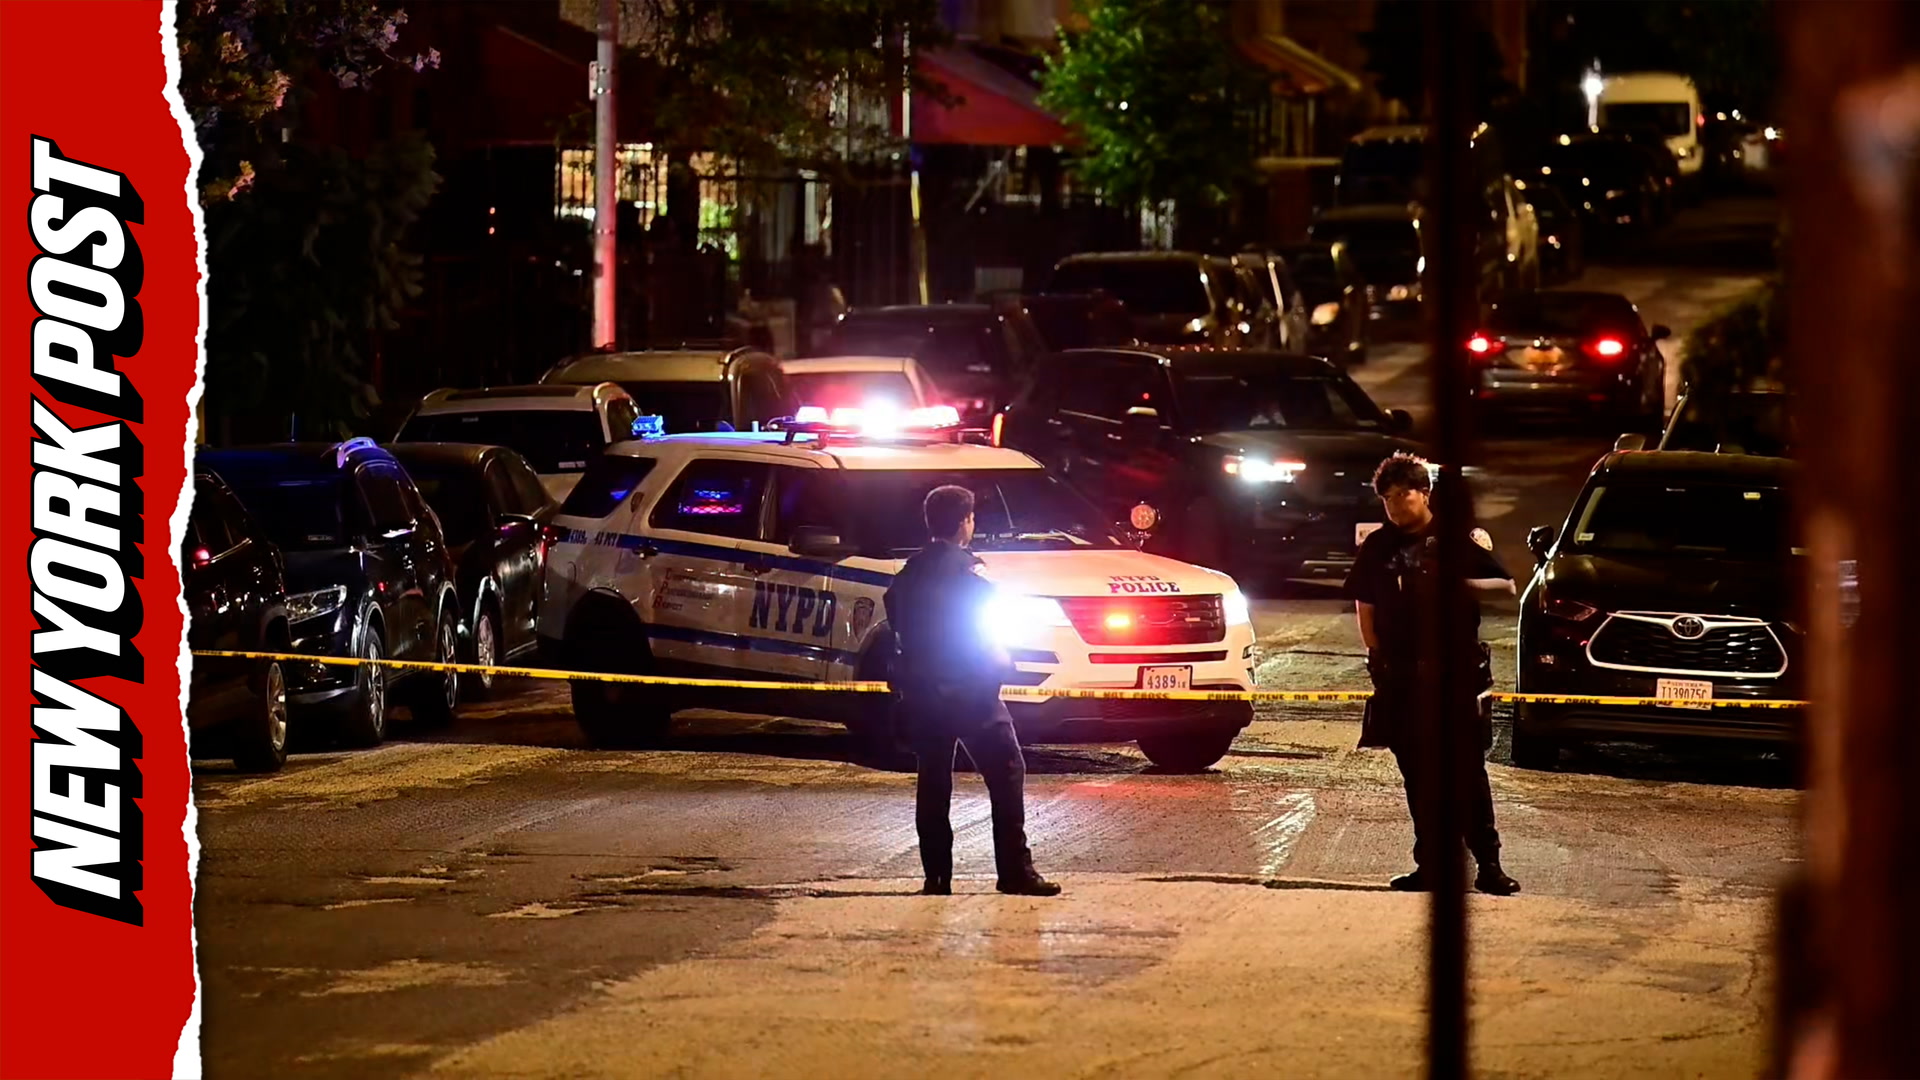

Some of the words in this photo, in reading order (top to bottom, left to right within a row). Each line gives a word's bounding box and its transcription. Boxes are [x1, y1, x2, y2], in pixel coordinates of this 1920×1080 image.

[1107, 582, 1180, 594] POLICE
[749, 581, 837, 637] NYPD
[1147, 674, 1176, 690] 4389
